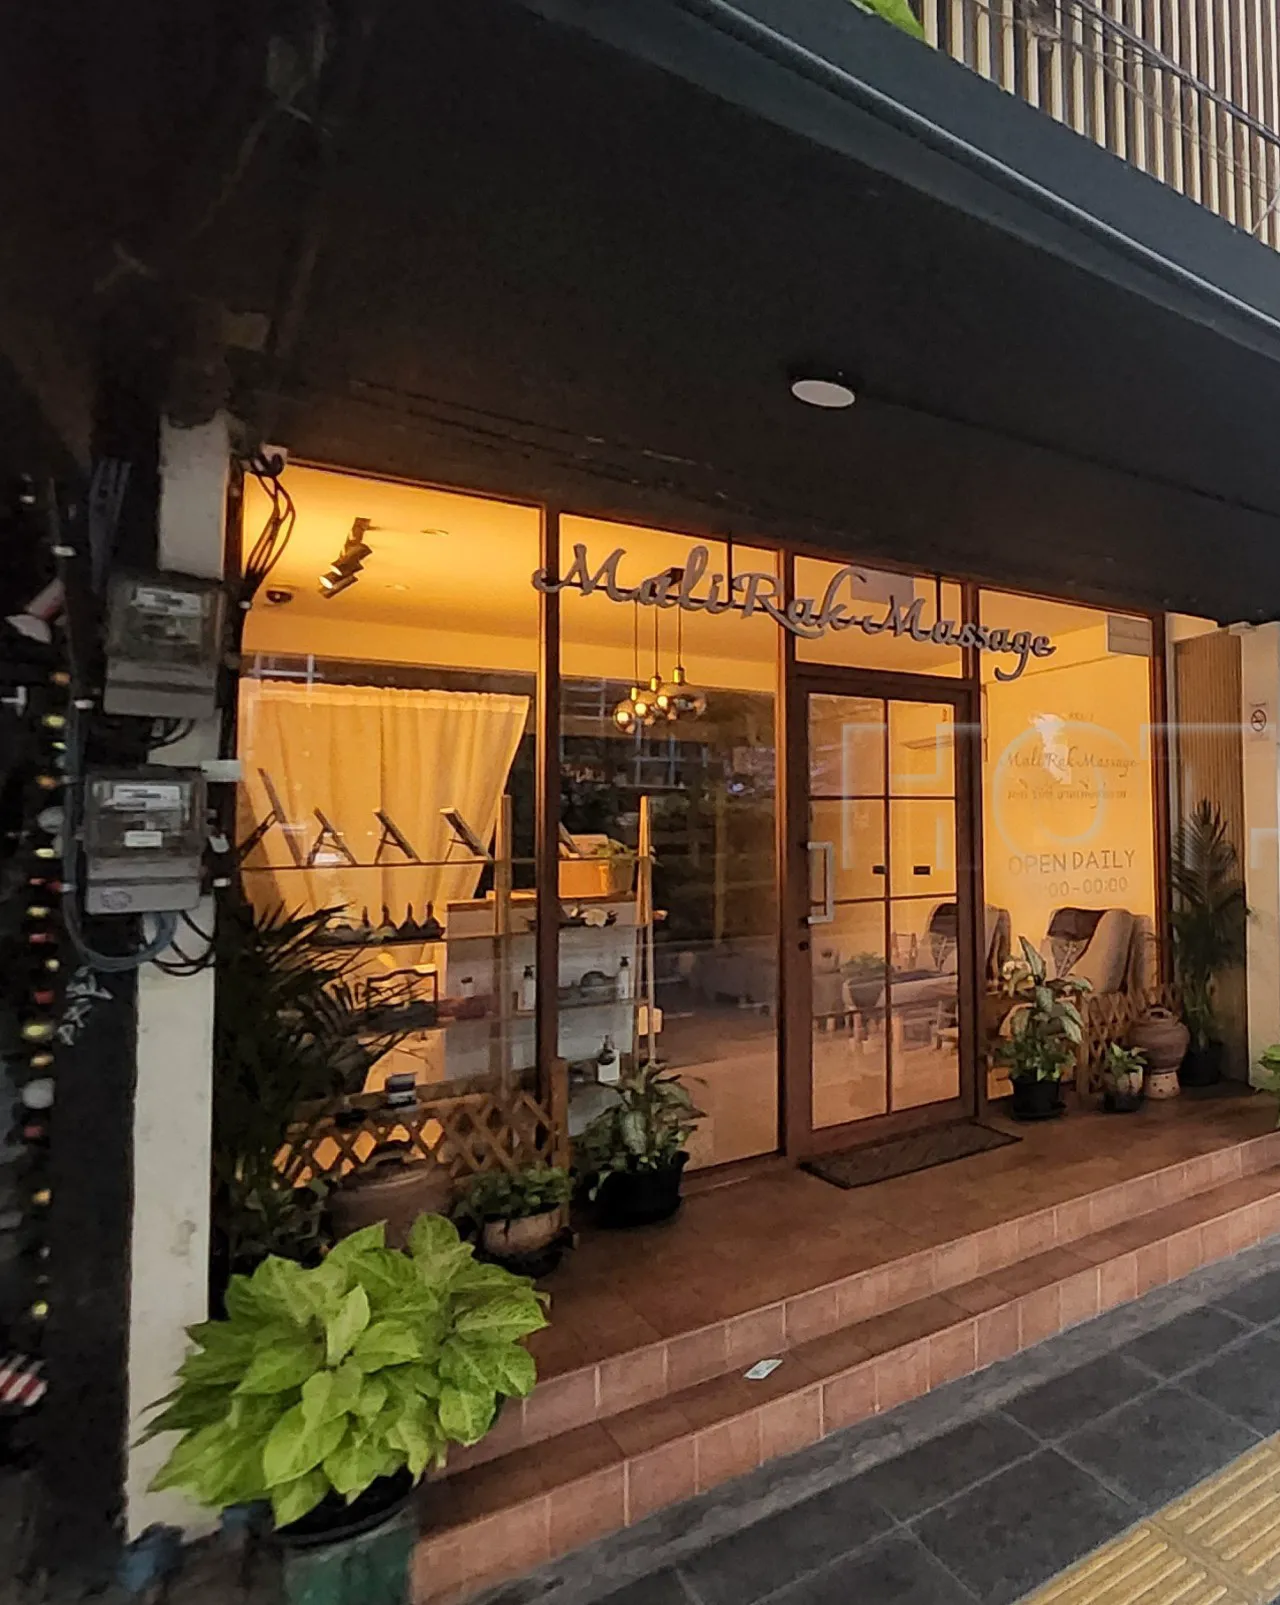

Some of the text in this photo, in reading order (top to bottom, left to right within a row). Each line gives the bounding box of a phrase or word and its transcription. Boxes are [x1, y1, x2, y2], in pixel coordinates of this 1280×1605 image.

[532, 542, 1058, 682] Mali Rak Massage
[1008, 849, 1137, 876] OPEN DAILY
